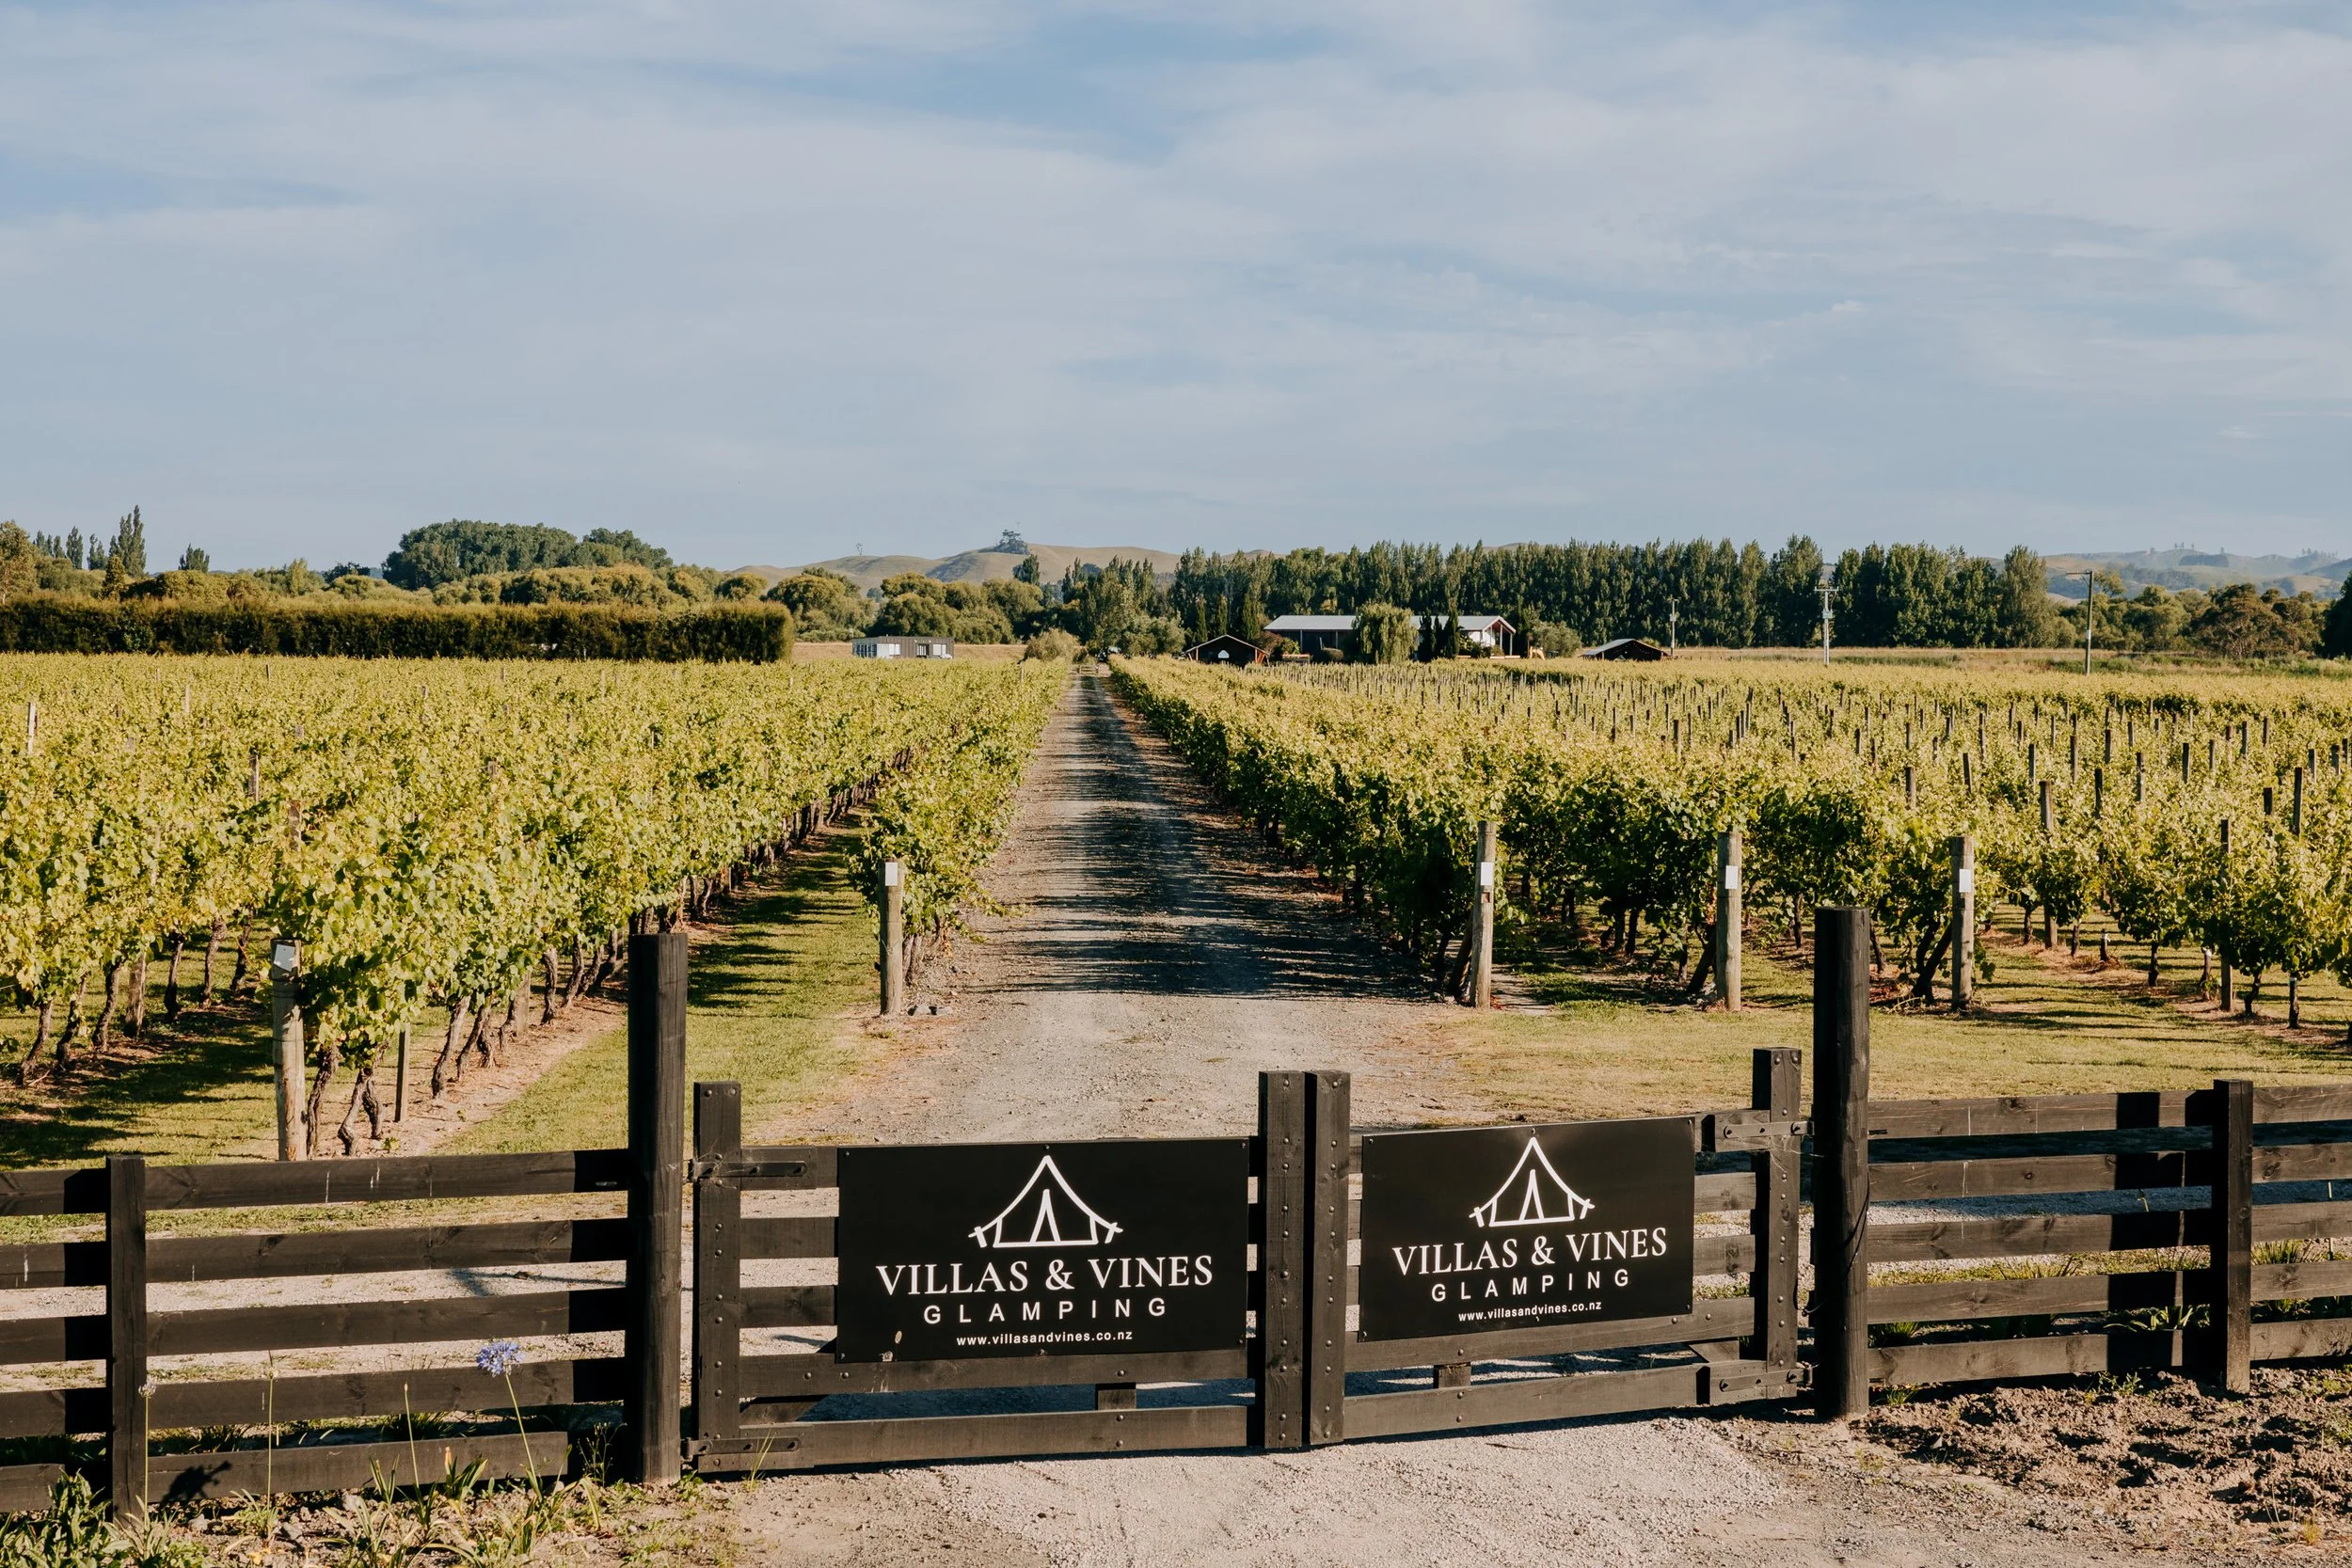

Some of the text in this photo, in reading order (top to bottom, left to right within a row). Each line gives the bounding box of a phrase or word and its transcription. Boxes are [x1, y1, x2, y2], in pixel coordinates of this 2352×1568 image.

[1391, 1227, 1667, 1276] VILLAS & VINES
[875, 1255, 1213, 1296] VILLAS & VINES
[1431, 1268, 1629, 1303] GLAMPING
[923, 1297, 1166, 1324] GLAMPING
[1457, 1301, 1602, 1323] www.villasandvines.co.nz
[956, 1331, 1133, 1346] www.villasandvines.co.nz
